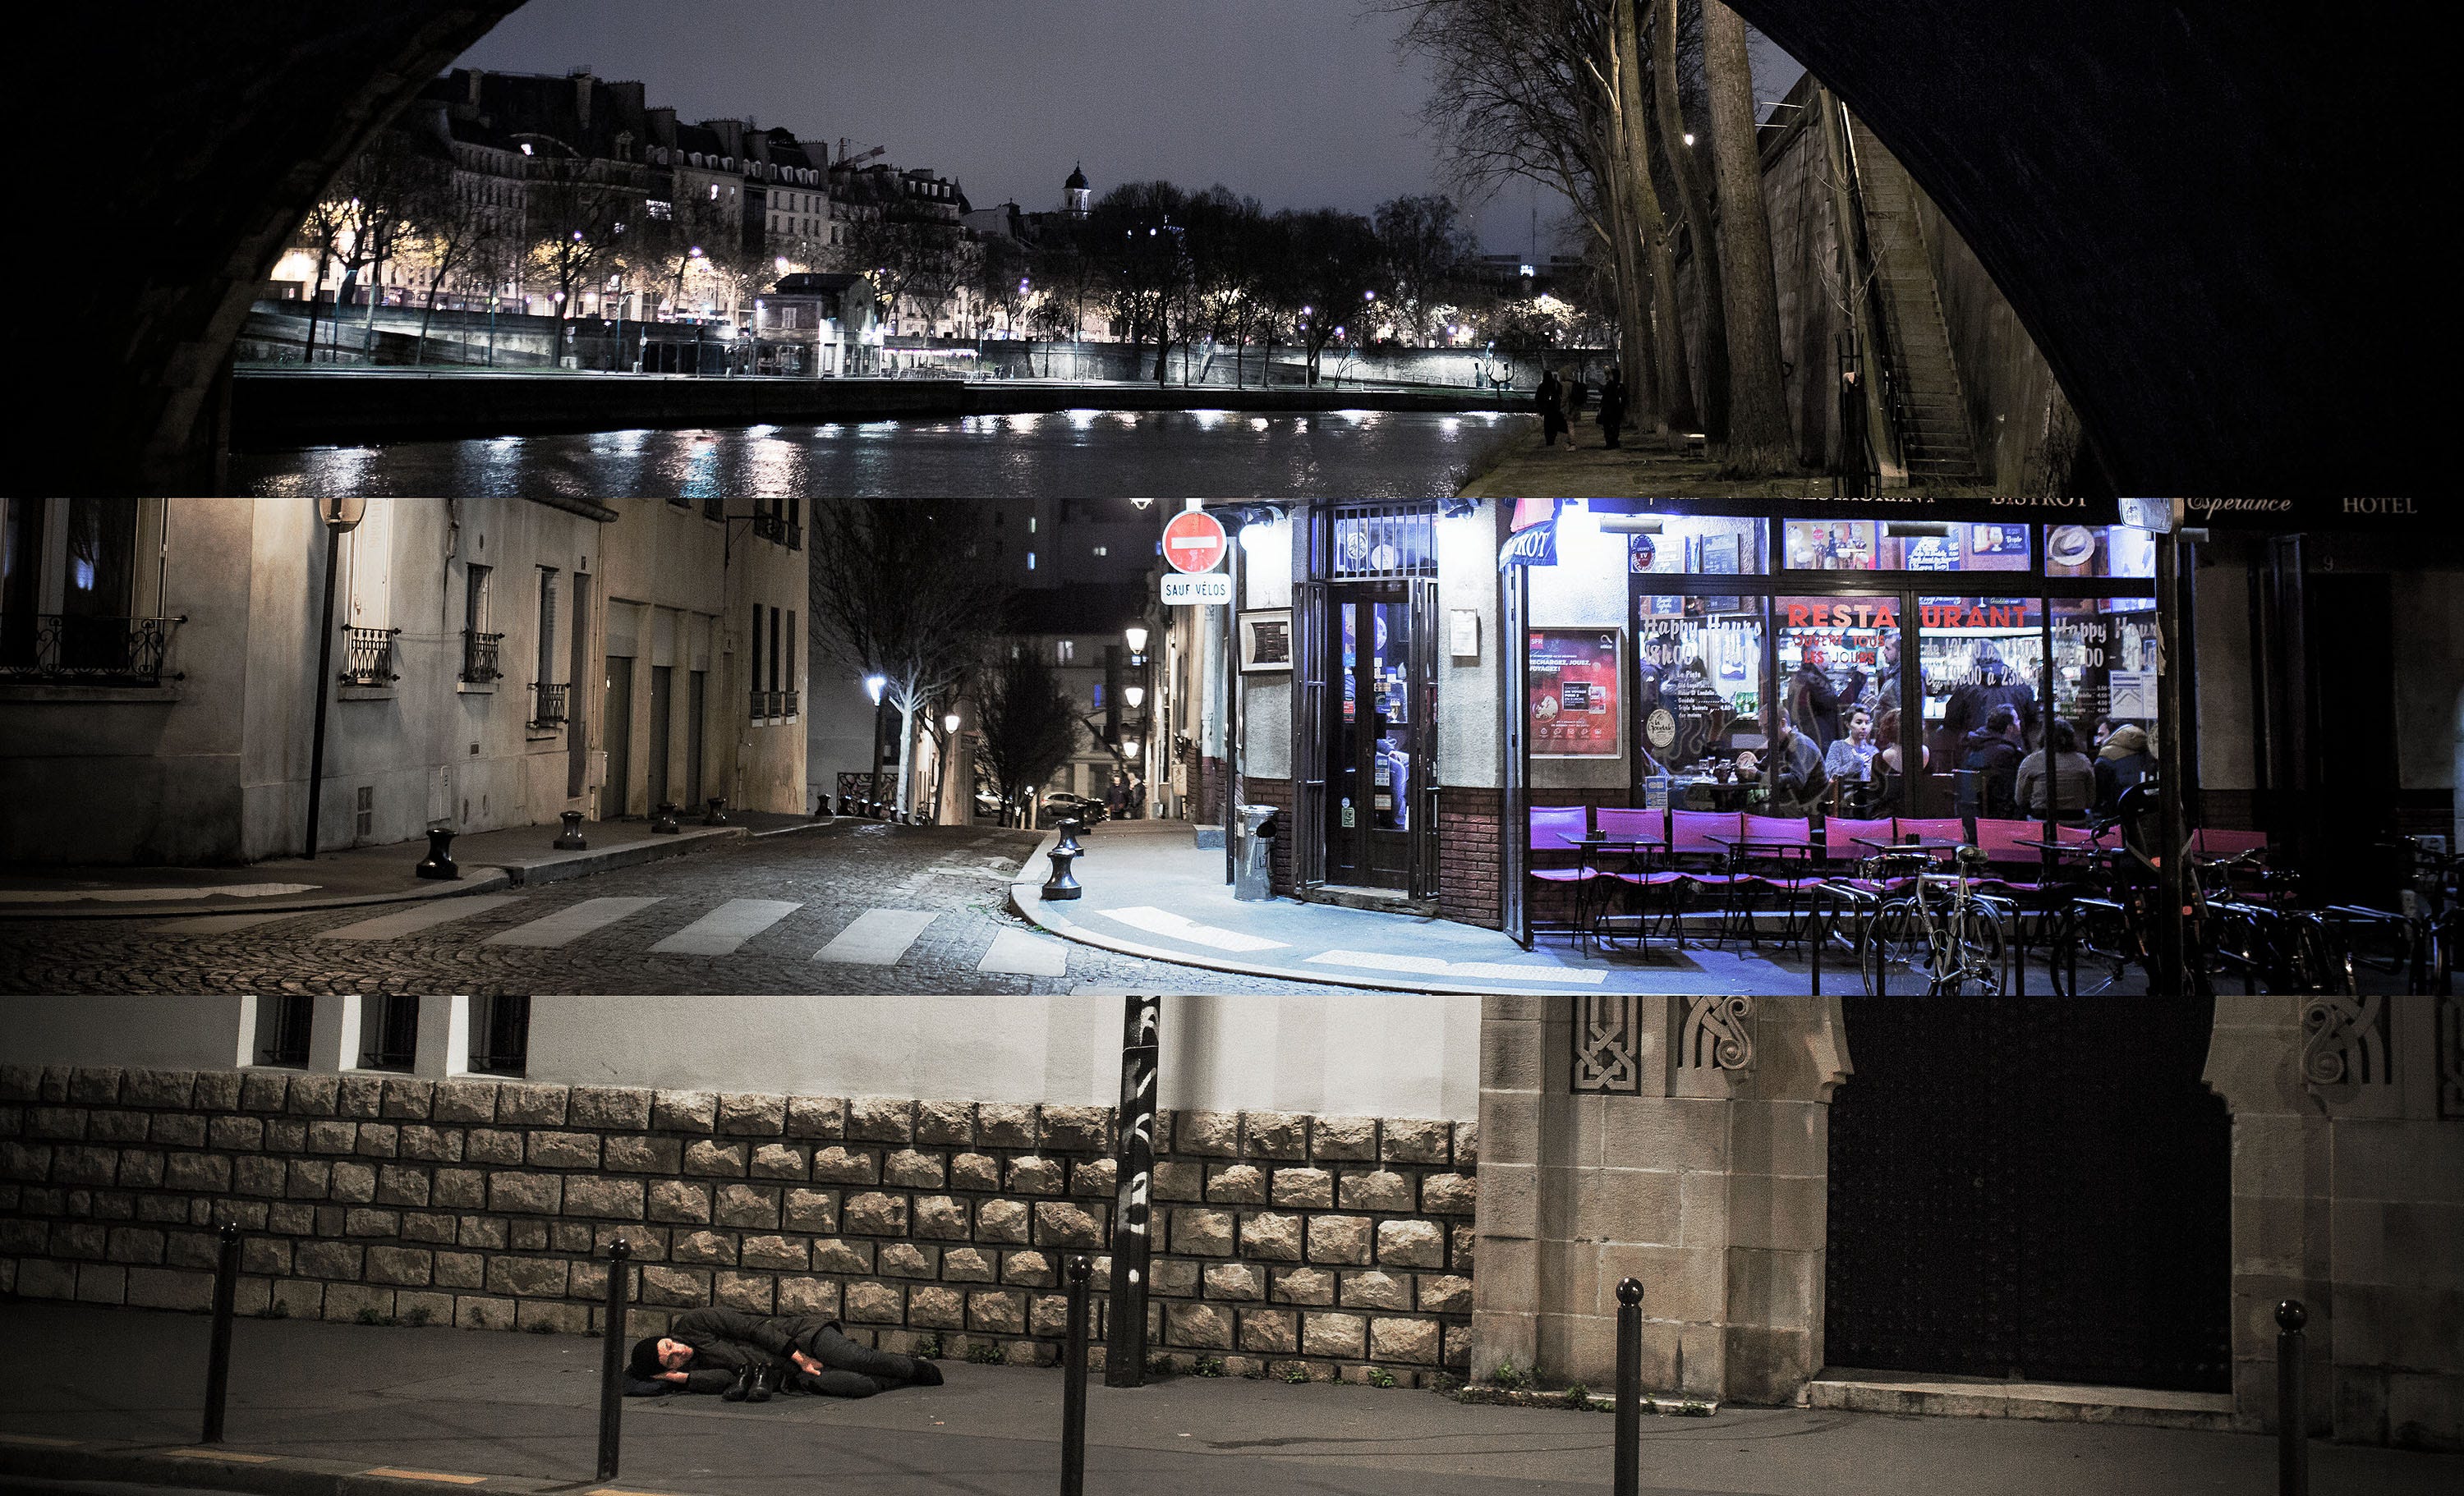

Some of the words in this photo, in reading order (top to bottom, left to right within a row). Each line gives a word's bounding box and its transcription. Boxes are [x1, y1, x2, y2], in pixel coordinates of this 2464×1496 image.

[2342, 498, 2418, 513] HOTEL
[1165, 584, 1190, 596] SAUF
[1195, 581, 1226, 596] VÉLOS
[1643, 616, 1699, 643] Happy
[2055, 617, 2107, 644] Happy
[1792, 634, 1842, 647] OUVERT
[1852, 635, 1886, 647] TOUS
[1803, 650, 1824, 664] LES
[1832, 651, 1875, 664] JOURS
